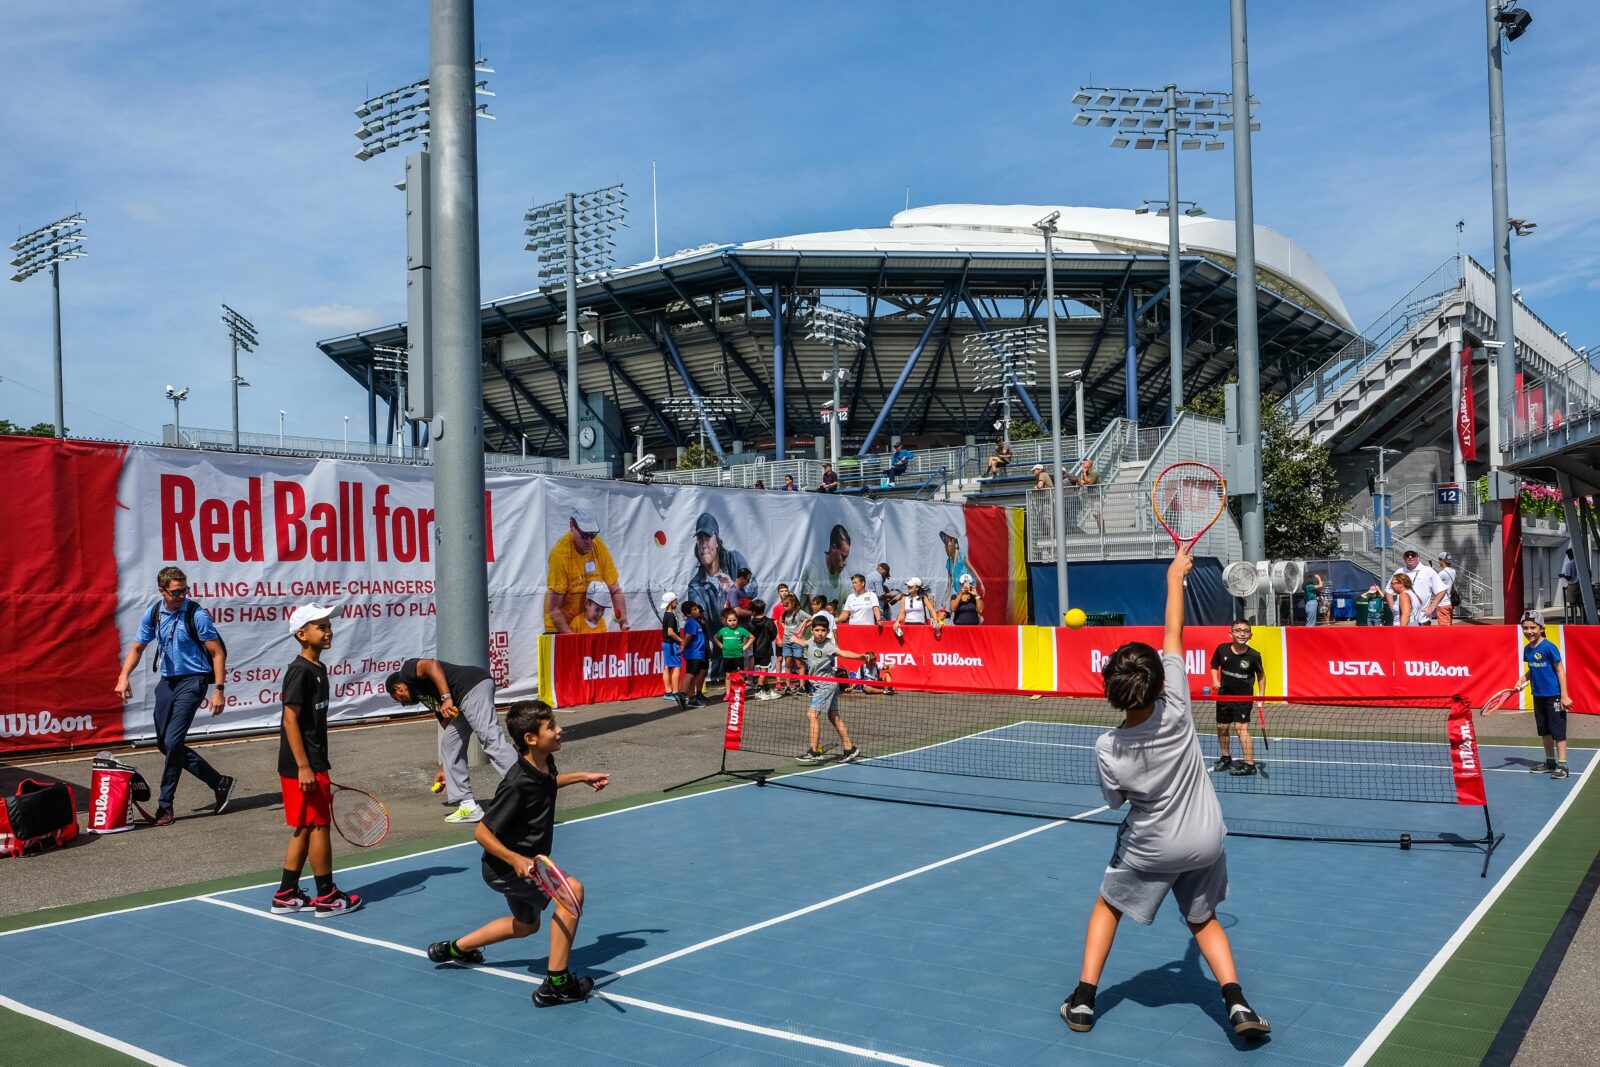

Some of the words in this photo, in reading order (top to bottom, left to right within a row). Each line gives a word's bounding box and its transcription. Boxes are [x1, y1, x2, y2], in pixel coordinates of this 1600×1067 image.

[821, 414, 830, 423] 11
[837, 411, 848, 421] 12
[1440, 490, 1457, 501] 12
[160, 473, 265, 562] Red
[273, 480, 366, 562] Ball
[372, 484, 435, 562] for
[254, 581, 287, 597] ALL
[240, 606, 277, 622] HAS
[340, 603, 382, 619] WAYS
[386, 602, 406, 617] TO
[409, 601, 437, 617] PLA
[360, 657, 404, 674] There'
[583, 655, 606, 680] Red
[608, 653, 632, 678] Ball
[633, 652, 651, 676] for
[652, 651, 664, 674] Al
[931, 652, 984, 667] Wilson
[1185, 650, 1206, 674] All
[246, 666, 282, 683] stay
[1328, 661, 1386, 676] USTA
[1404, 661, 1472, 677] Wilson
[334, 681, 373, 698] USTA
[730, 687, 742, 726] Wilson
[0, 711, 94, 738] Wilson
[93, 774, 111, 827] Wilson
